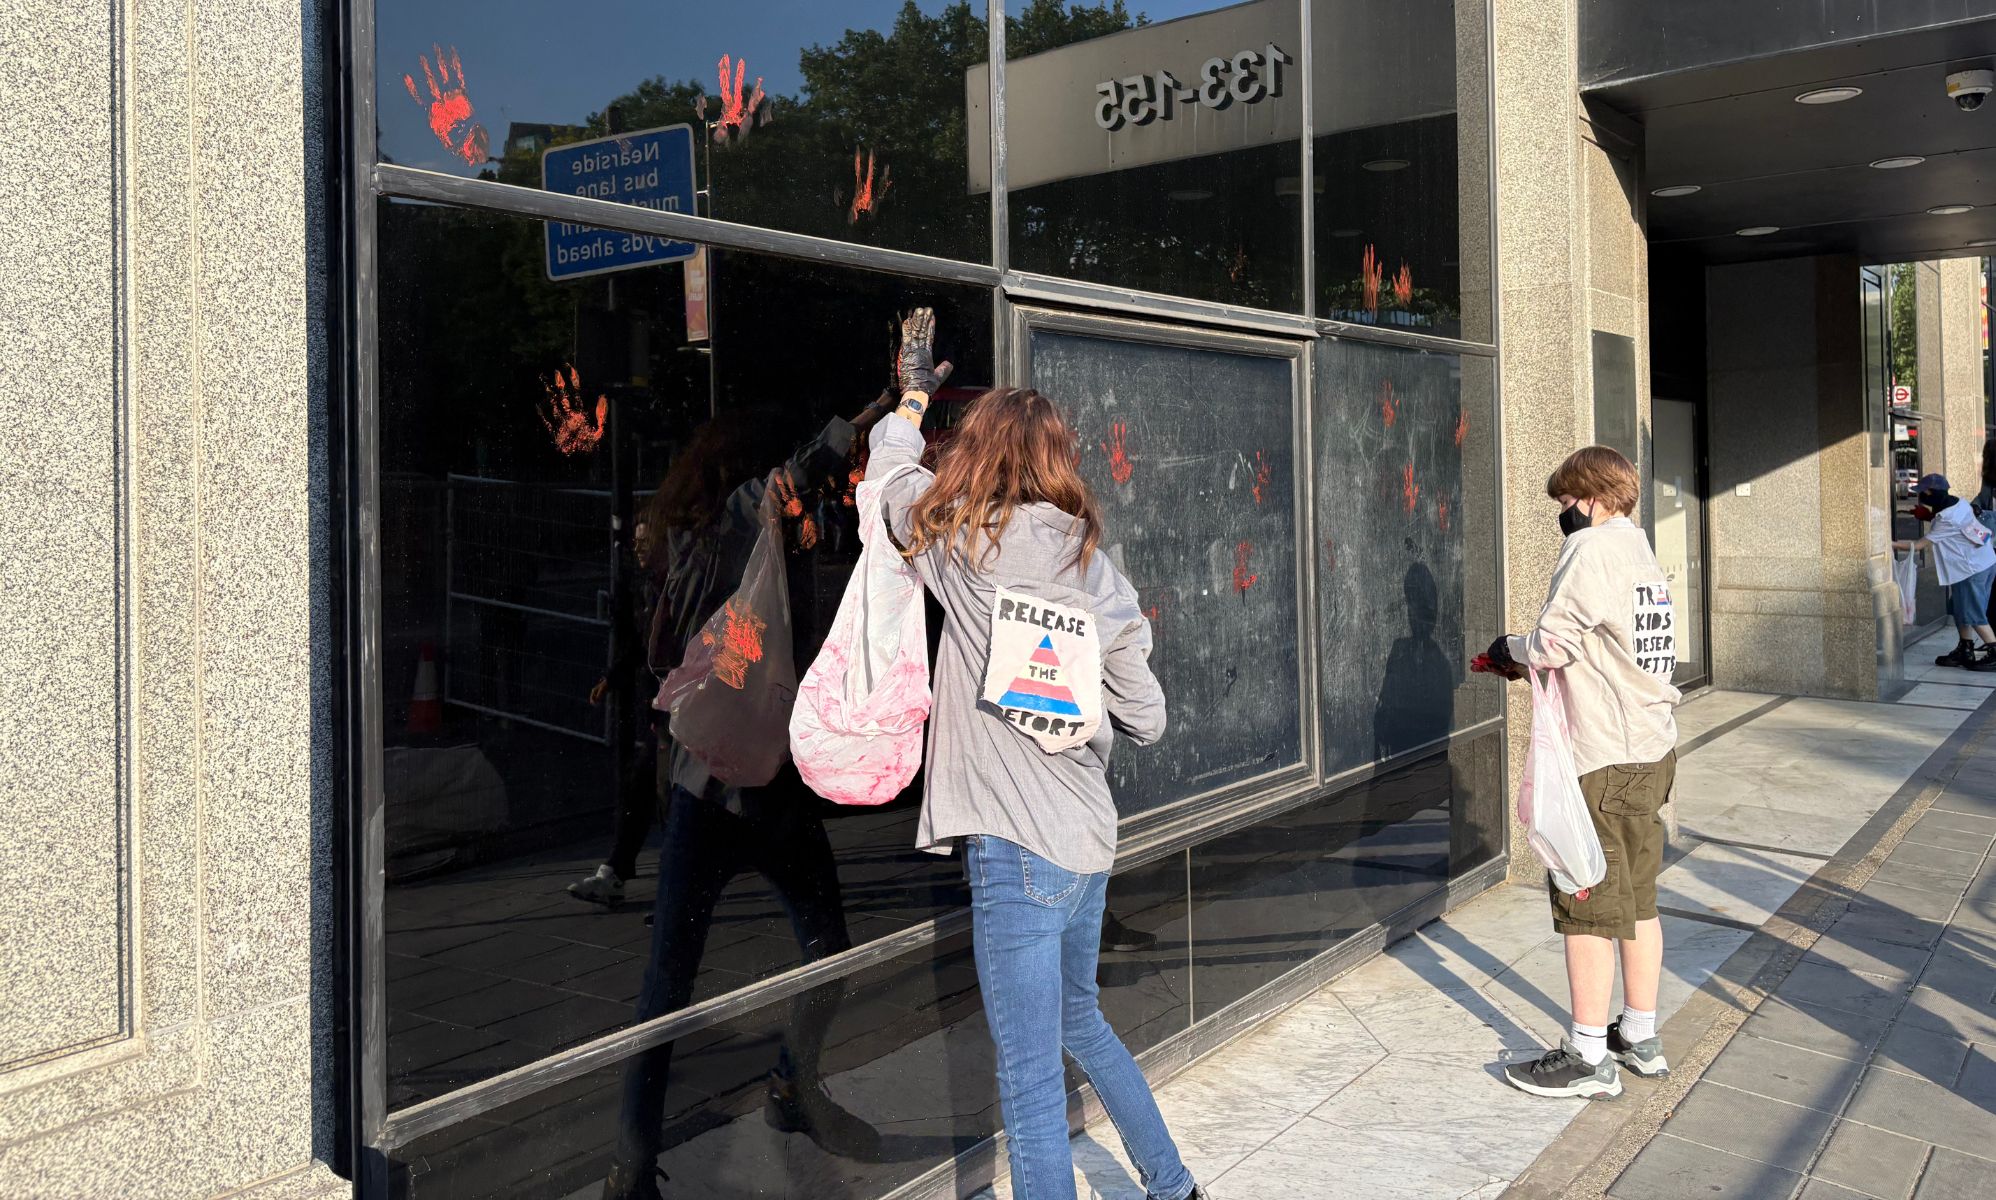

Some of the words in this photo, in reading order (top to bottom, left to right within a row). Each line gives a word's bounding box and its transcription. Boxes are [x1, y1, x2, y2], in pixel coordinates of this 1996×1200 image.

[998, 598, 1085, 637] RELEASE
[1635, 612, 1671, 631] KIDS
[1635, 635, 1675, 653] DESER
[1028, 665, 1058, 680] THE
[1001, 706, 1085, 737] EPORT
